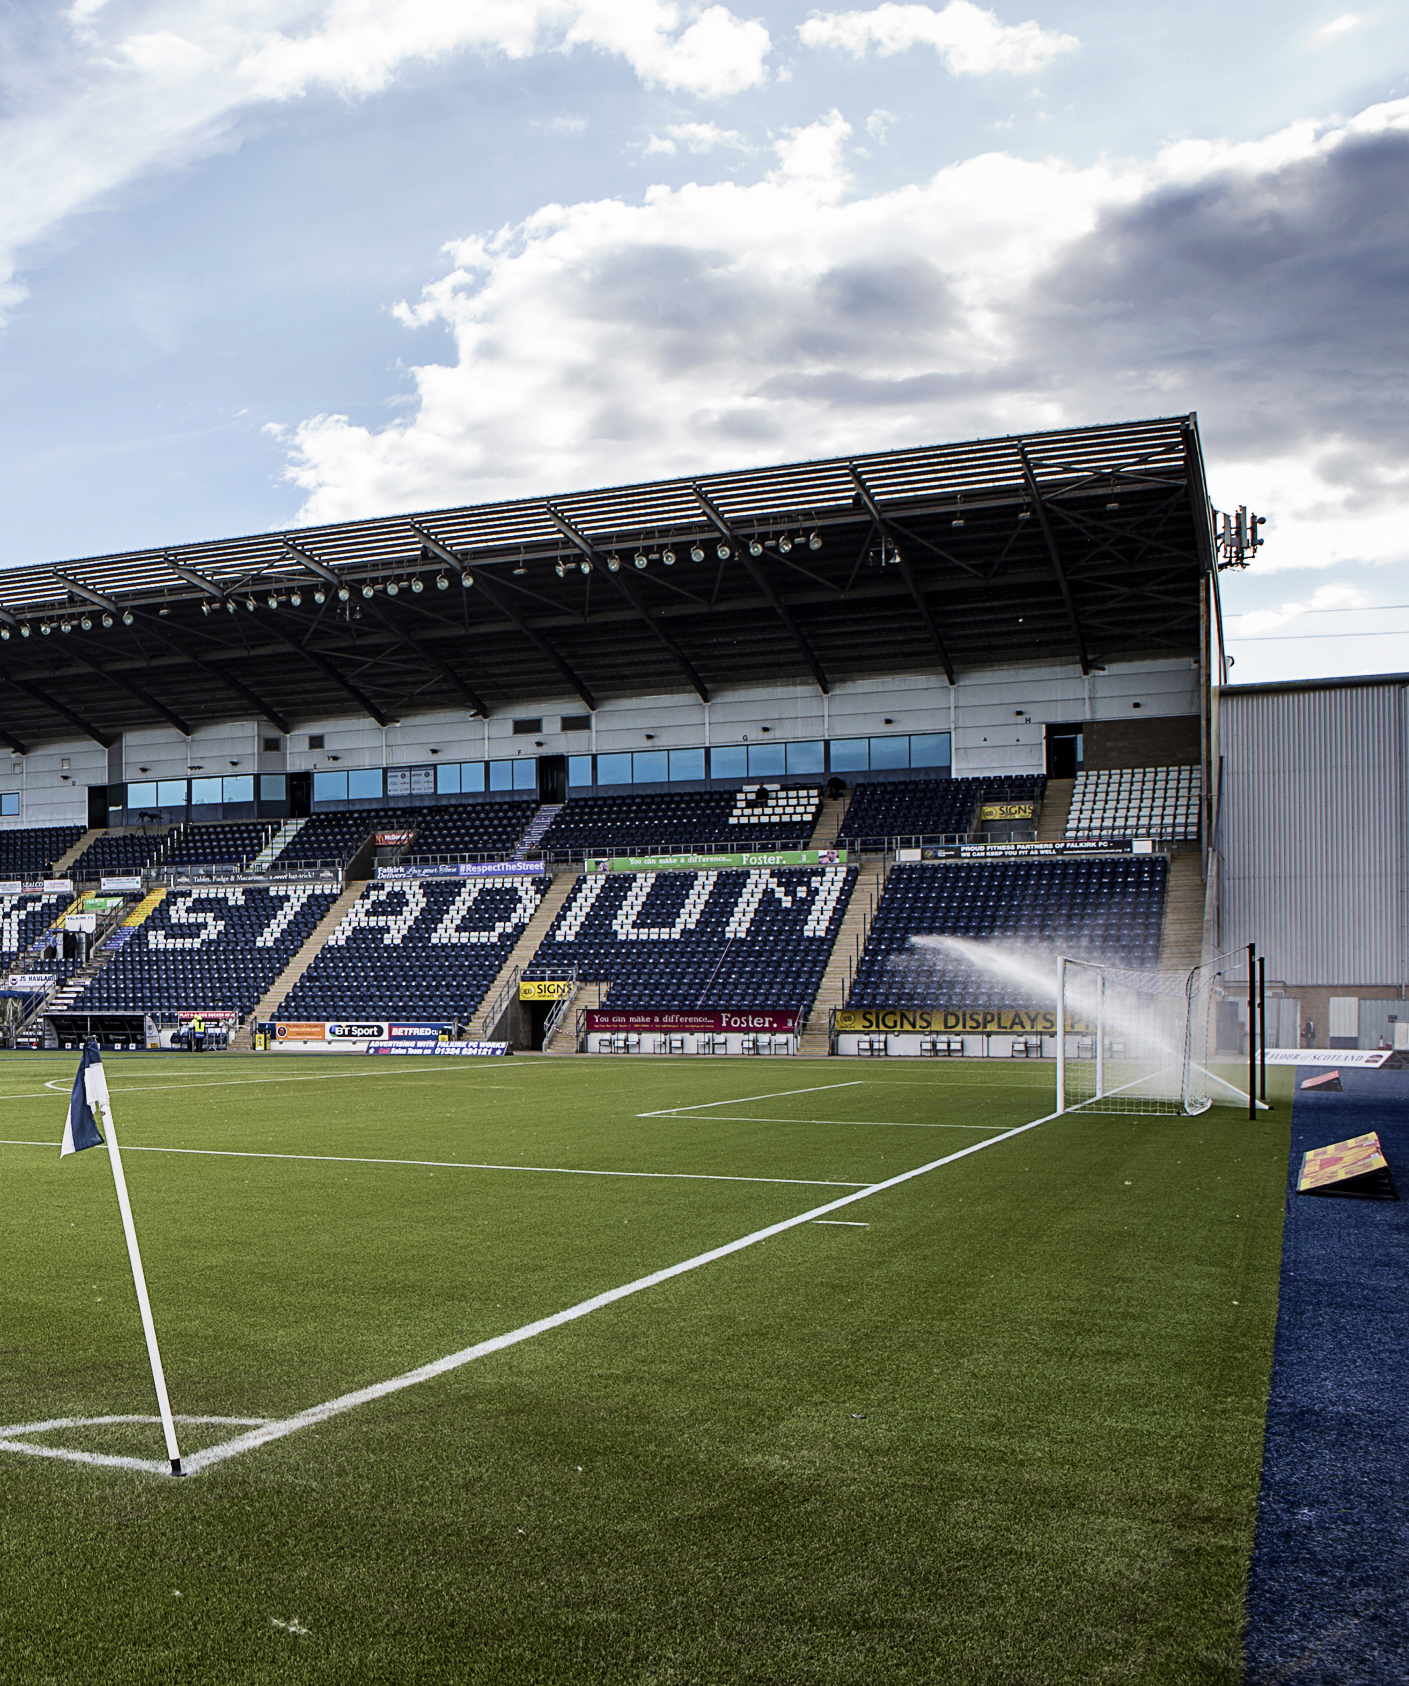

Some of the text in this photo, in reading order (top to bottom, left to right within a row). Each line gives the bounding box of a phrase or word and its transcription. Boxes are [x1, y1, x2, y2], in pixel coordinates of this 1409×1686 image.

[999, 804, 1034, 815] SIGNS
[1016, 842, 1053, 850] PARTNERS
[629, 857, 642, 865] You
[659, 856, 677, 864] make
[742, 853, 786, 866] Foster.
[460, 861, 544, 873] #RespectTheStreet
[537, 984, 573, 994] SIGNS
[593, 1015, 609, 1023] You
[663, 1014, 714, 1023] difference...
[721, 1013, 778, 1027] Foster.
[861, 1011, 932, 1029] SIGNS
[943, 1011, 1055, 1030] DISPLAYS
[335, 1026, 378, 1036] BT Sport
